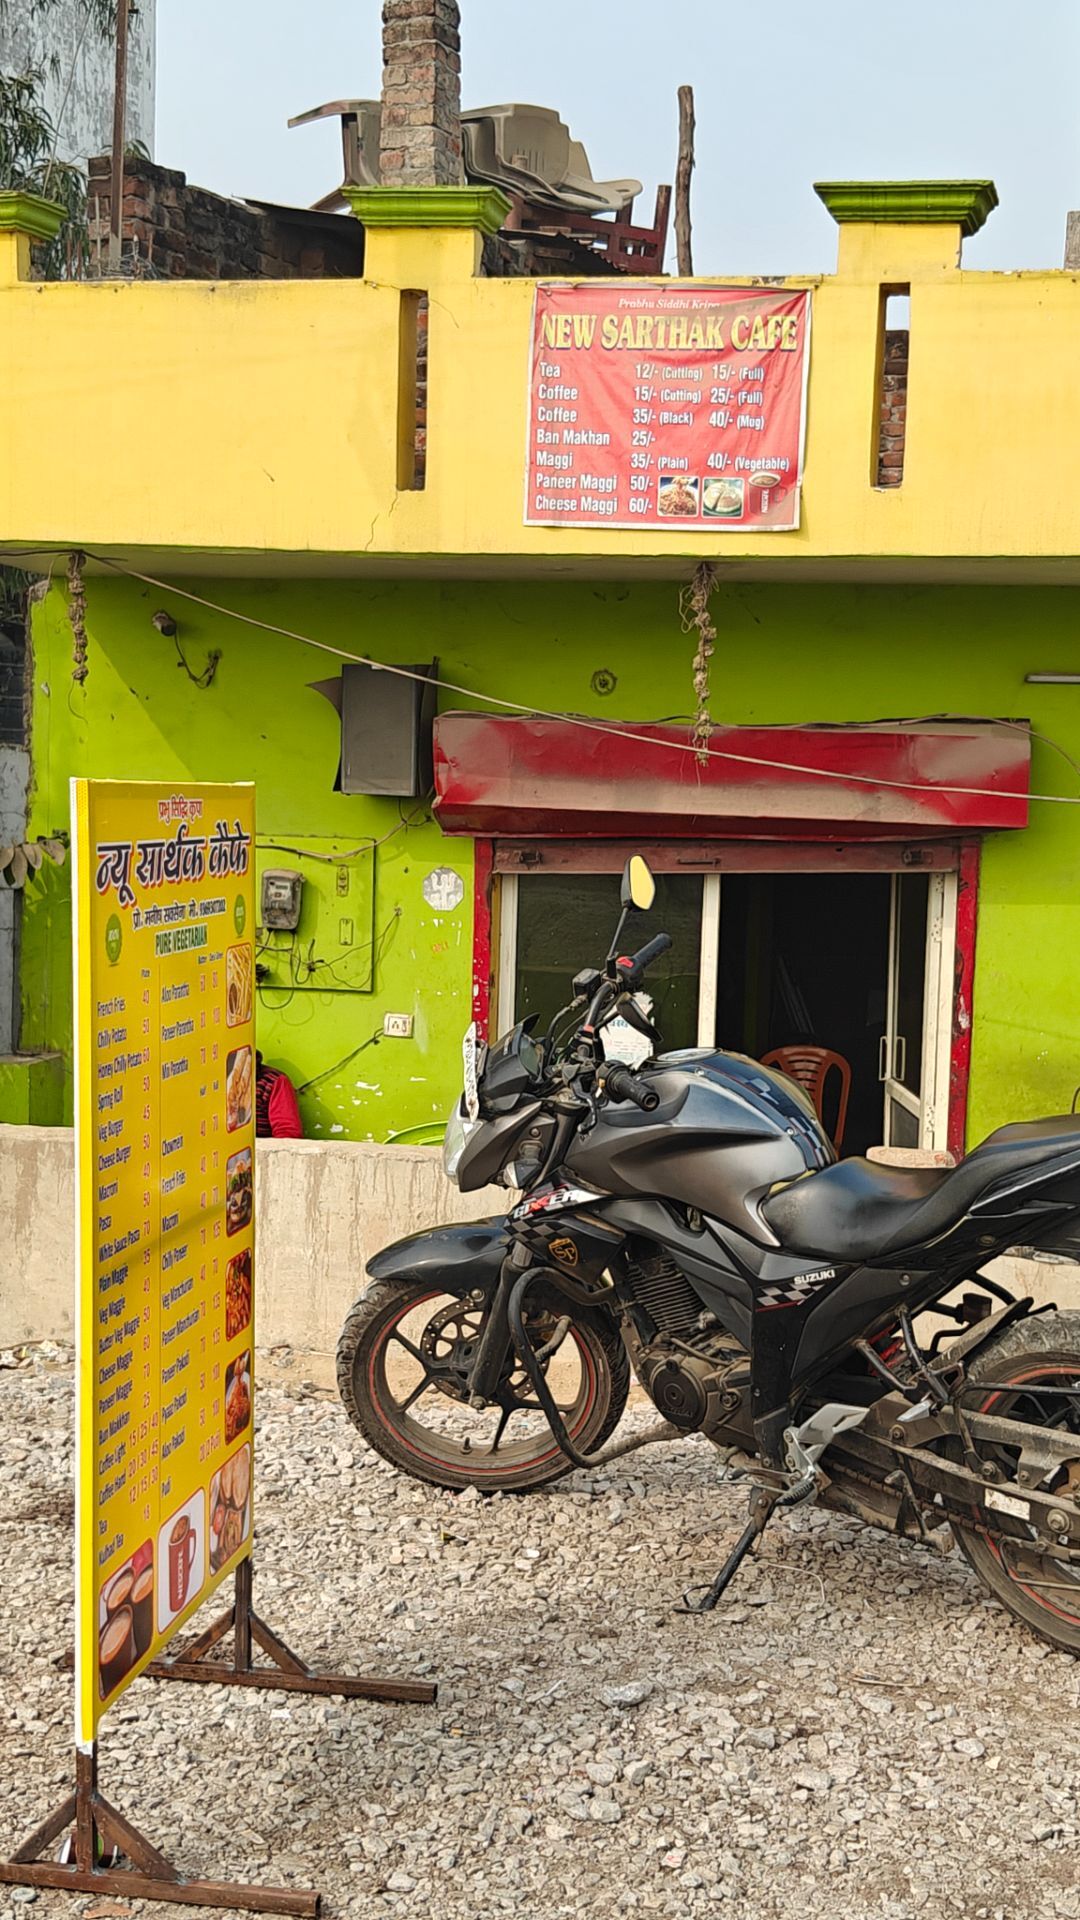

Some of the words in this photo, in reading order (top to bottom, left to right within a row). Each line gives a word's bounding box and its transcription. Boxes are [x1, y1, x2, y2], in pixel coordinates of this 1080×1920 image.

[619, 297, 655, 309] Prabhu
[656, 297, 690, 309] Siddhi
[540, 314, 597, 350] NEW
[601, 314, 725, 351] SARTHAK
[731, 314, 798, 352] CAFE
[540, 362, 561, 378] Tea
[636, 364, 659, 380] 12/-
[662, 366, 703, 383] (Cutting)
[712, 364, 736, 381] 15/-
[739, 367, 765, 384] (Full)
[538, 384, 578, 400] Coffee
[634, 386, 657, 402] 15/-
[660, 388, 702, 404] (Cutting)
[710, 387, 735, 405] 25/-
[738, 390, 763, 407] (Full)
[537, 406, 577, 422] Coffee
[633, 408, 656, 425] 35/-
[659, 411, 694, 427] (Black)
[709, 410, 734, 428] 40/-
[737, 415, 765, 431] (Mug)
[536, 429, 559, 444] Ban
[562, 430, 610, 446] Makhan
[632, 430, 656, 447] 25/-
[536, 451, 573, 470] Maggi
[630, 453, 655, 469] 35/-
[657, 456, 689, 471] (Plain)
[707, 453, 732, 471] 40/-
[734, 457, 790, 473] (Vegetable)
[536, 473, 578, 489] Paneer
[580, 474, 618, 493] Maggi
[630, 475, 654, 492] 50/-
[535, 495, 577, 512] Cheese
[580, 496, 619, 515] Maggi
[629, 498, 653, 515] 60/-
[96, 841, 136, 906] न्यू
[136, 823, 206, 887] सार्थक
[208, 819, 250, 879] कैफे
[155, 930, 172, 956] PURE
[173, 924, 208, 952] VEGETARIAN
[794, 1269, 836, 1286] SUZUKI
